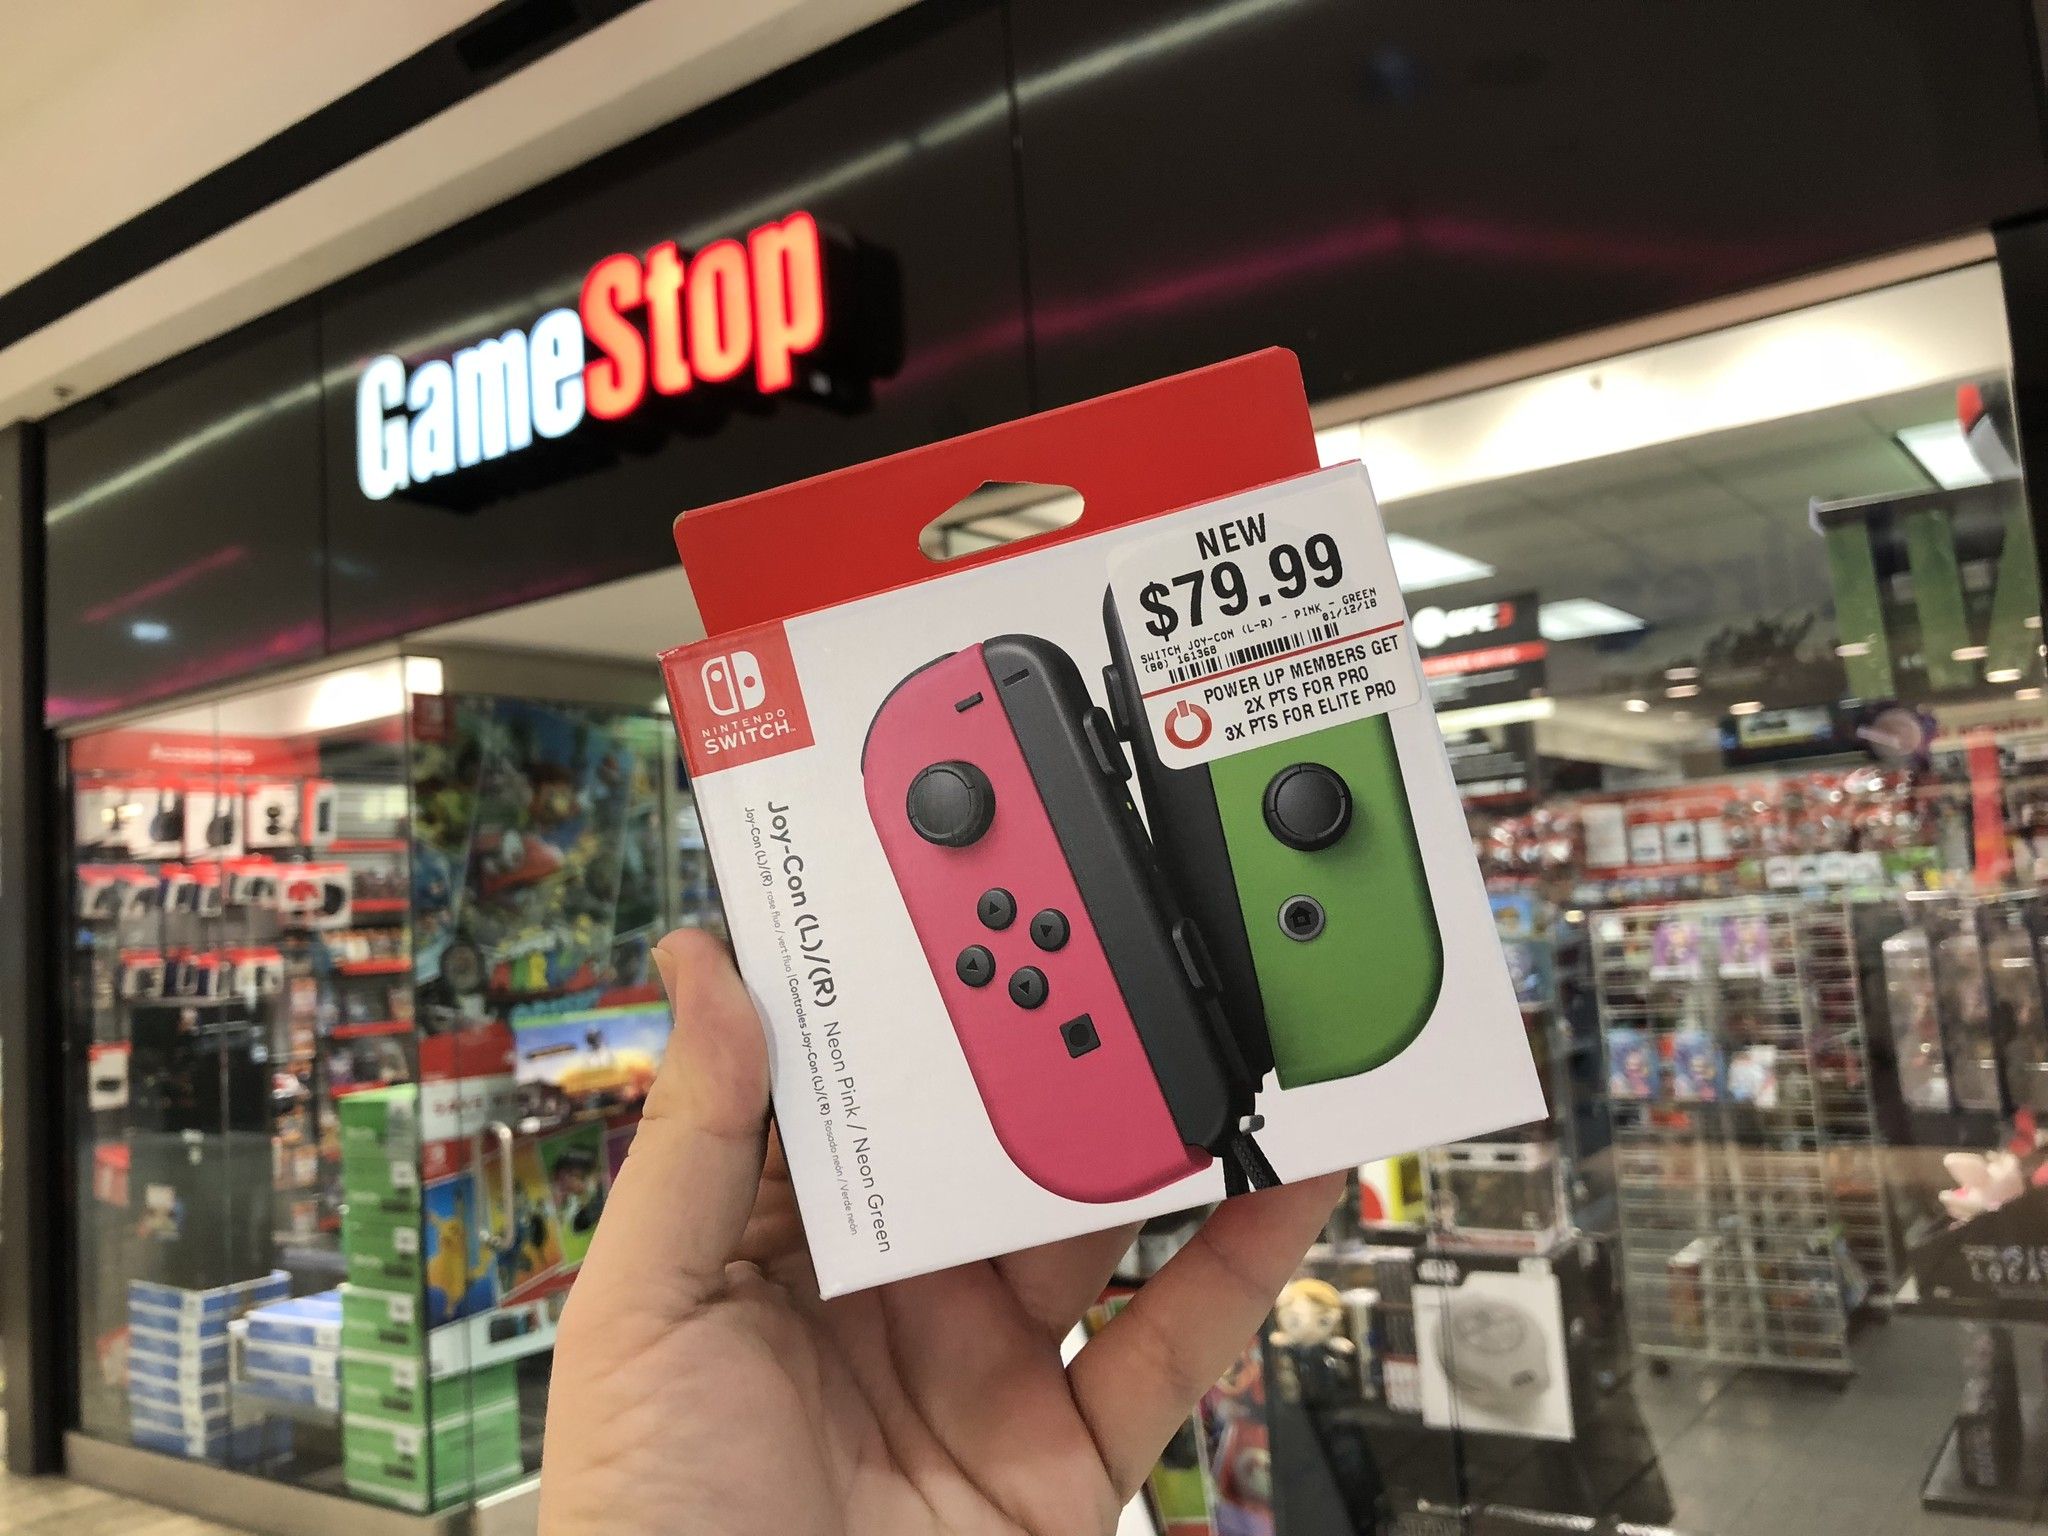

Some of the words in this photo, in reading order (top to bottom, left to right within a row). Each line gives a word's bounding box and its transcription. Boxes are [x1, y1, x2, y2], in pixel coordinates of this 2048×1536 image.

[356, 210, 824, 501] GameStop
[1196, 512, 1267, 560] NEW
[1139, 533, 1343, 641] $79.99
[1141, 645, 1181, 665] SWITCH
[1188, 628, 1235, 650] JOY-CON
[1242, 617, 1274, 635] (L-R)
[1294, 603, 1323, 620] PINK
[1341, 587, 1377, 607] GREEN
[1177, 645, 1218, 664] 161368
[1322, 598, 1377, 622] 01/12/18
[1203, 675, 1259, 704] POWER
[1265, 666, 1284, 687] UP
[1291, 645, 1366, 680] MEMBERS
[1371, 634, 1399, 659] GET
[1244, 694, 1266, 715] 2X
[1270, 686, 1298, 707] PTS
[1303, 676, 1334, 698] FOR
[1339, 665, 1369, 689] PRO
[701, 708, 786, 738] NINTENDO
[704, 719, 790, 755] SWITCH
[1224, 722, 1246, 742] 3X
[1250, 714, 1279, 735] PTS
[1284, 703, 1315, 725] FOR
[1320, 690, 1362, 715] ELITE
[1366, 679, 1397, 702] PRO
[744, 807, 762, 849] Joy-Con
[754, 850, 774, 887] (L)/(R)
[766, 890, 776, 911] rose
[777, 935, 789, 955] vert
[801, 1029, 819, 1074] Joy-Con
[767, 801, 808, 908] Joy-Con
[794, 913, 838, 1008] (L)/(R)
[823, 1021, 846, 1072] Neon
[837, 1076, 861, 1119] Pink
[852, 1137, 876, 1189] Neon
[867, 1193, 891, 1253] Green
